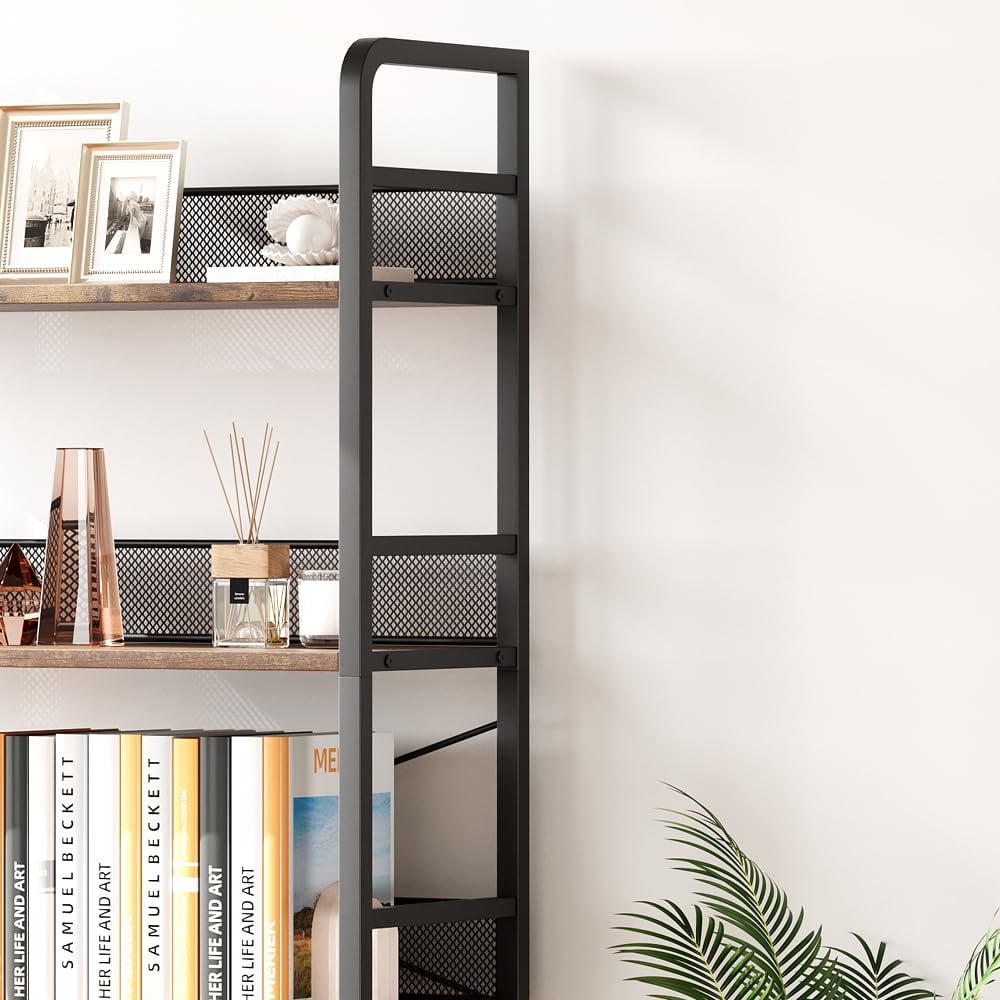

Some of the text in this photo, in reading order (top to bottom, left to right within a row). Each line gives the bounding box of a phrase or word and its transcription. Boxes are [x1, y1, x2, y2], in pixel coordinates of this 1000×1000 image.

[62, 757, 74, 969] SAMUEL BECKETT
[148, 758, 161, 972] SAMUEL BECKETT
[208, 865, 223, 897] ART
[241, 867, 255, 897] ART
[14, 861, 26, 998] HER LIFE AND ART
[99, 863, 111, 999] HER LIFE AND ART
[208, 899, 223, 935] AND
[241, 900, 255, 935] AND
[208, 937, 223, 969] LIFE
[241, 939, 255, 969] LIFE
